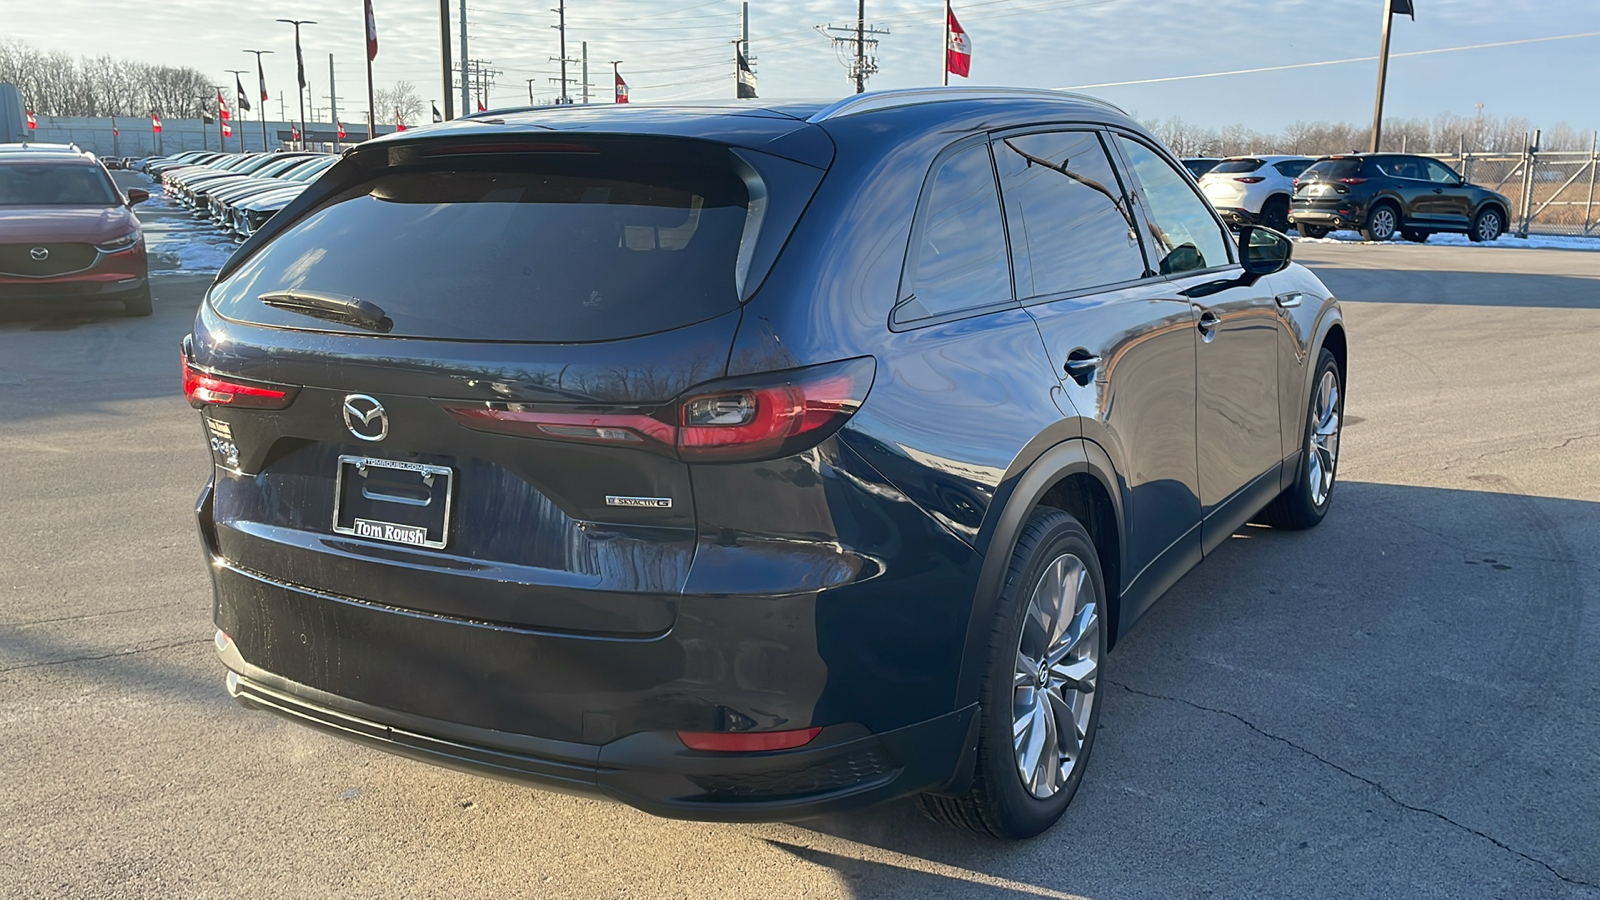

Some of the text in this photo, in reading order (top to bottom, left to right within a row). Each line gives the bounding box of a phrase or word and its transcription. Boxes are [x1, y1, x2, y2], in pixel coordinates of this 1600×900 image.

[367, 459, 424, 471] TOMROUSH.COM
[356, 521, 424, 544] Tom Roush
